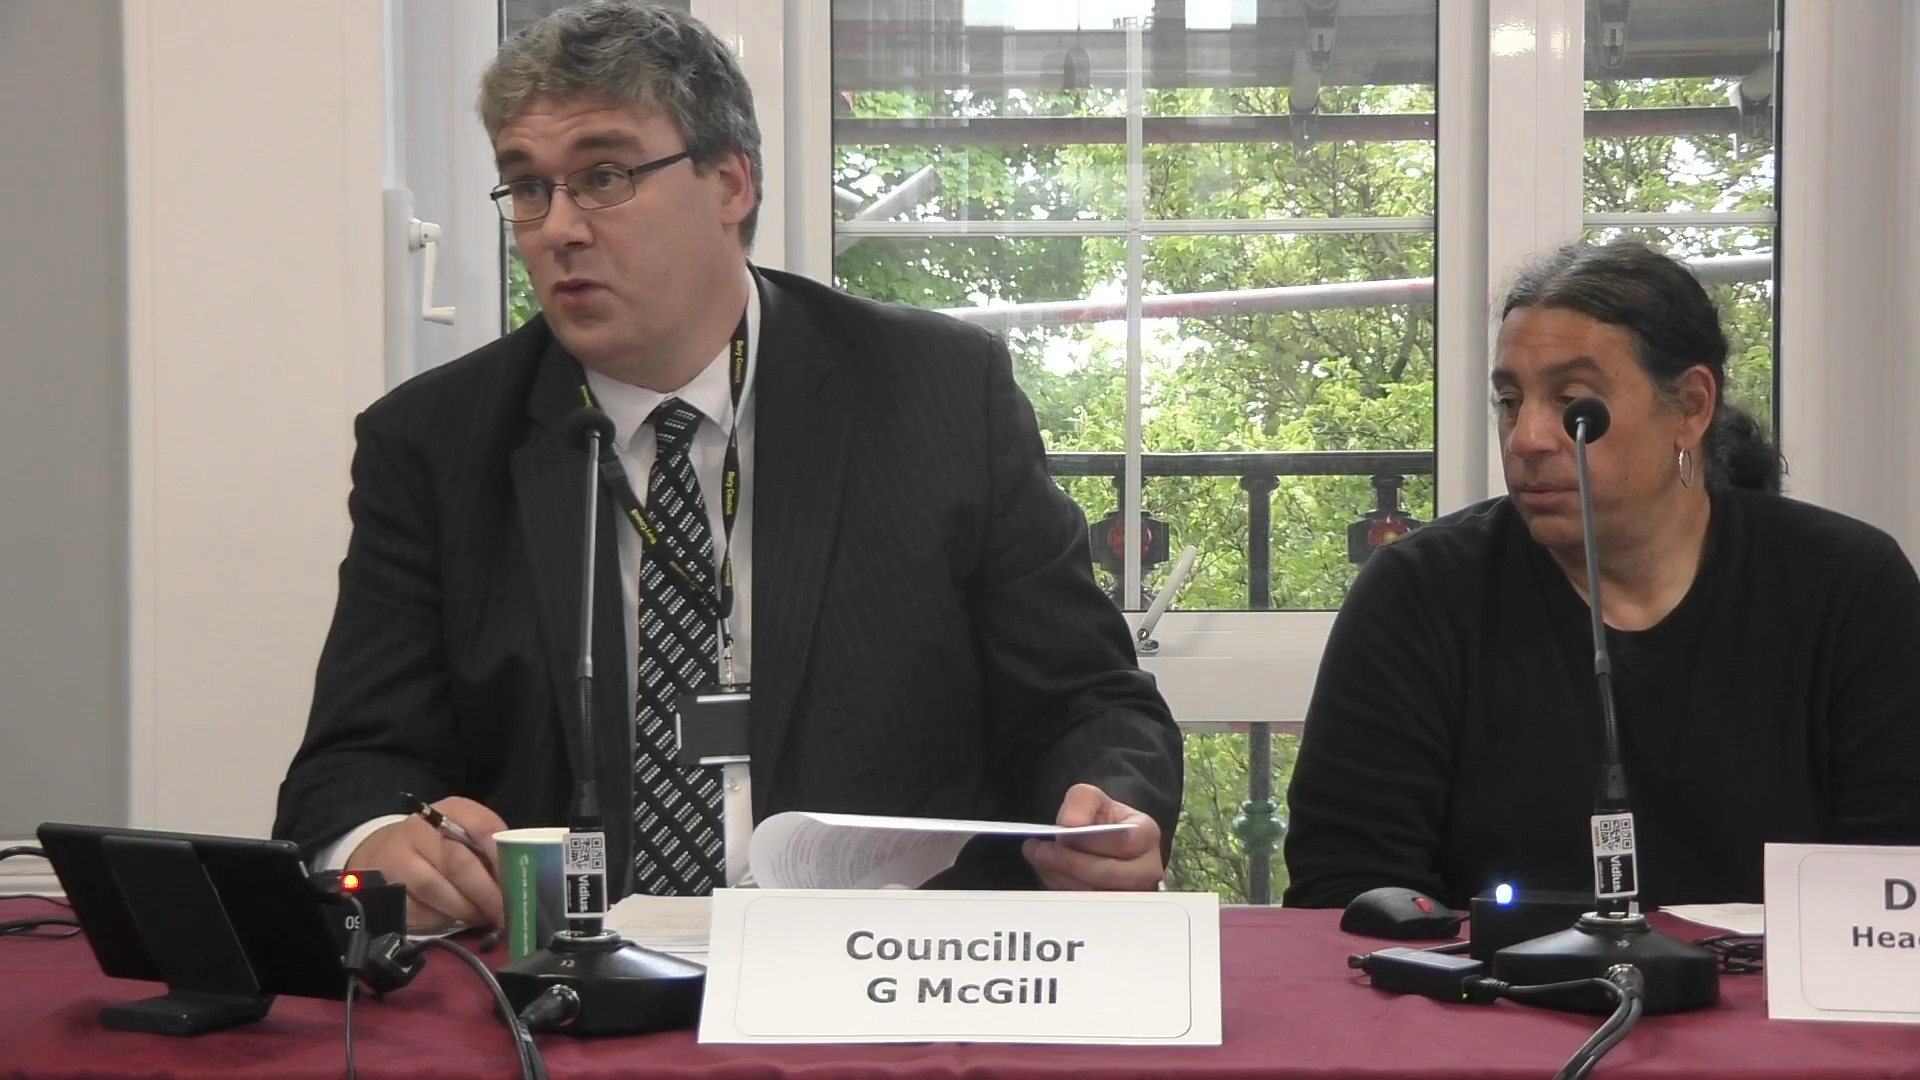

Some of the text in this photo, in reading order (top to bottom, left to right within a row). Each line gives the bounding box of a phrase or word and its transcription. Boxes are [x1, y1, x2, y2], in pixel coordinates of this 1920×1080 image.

[1884, 878, 1917, 910] D
[846, 930, 1085, 962] Councillor
[1852, 925, 1920, 949] Hea
[867, 976, 1058, 1004] G McGill
